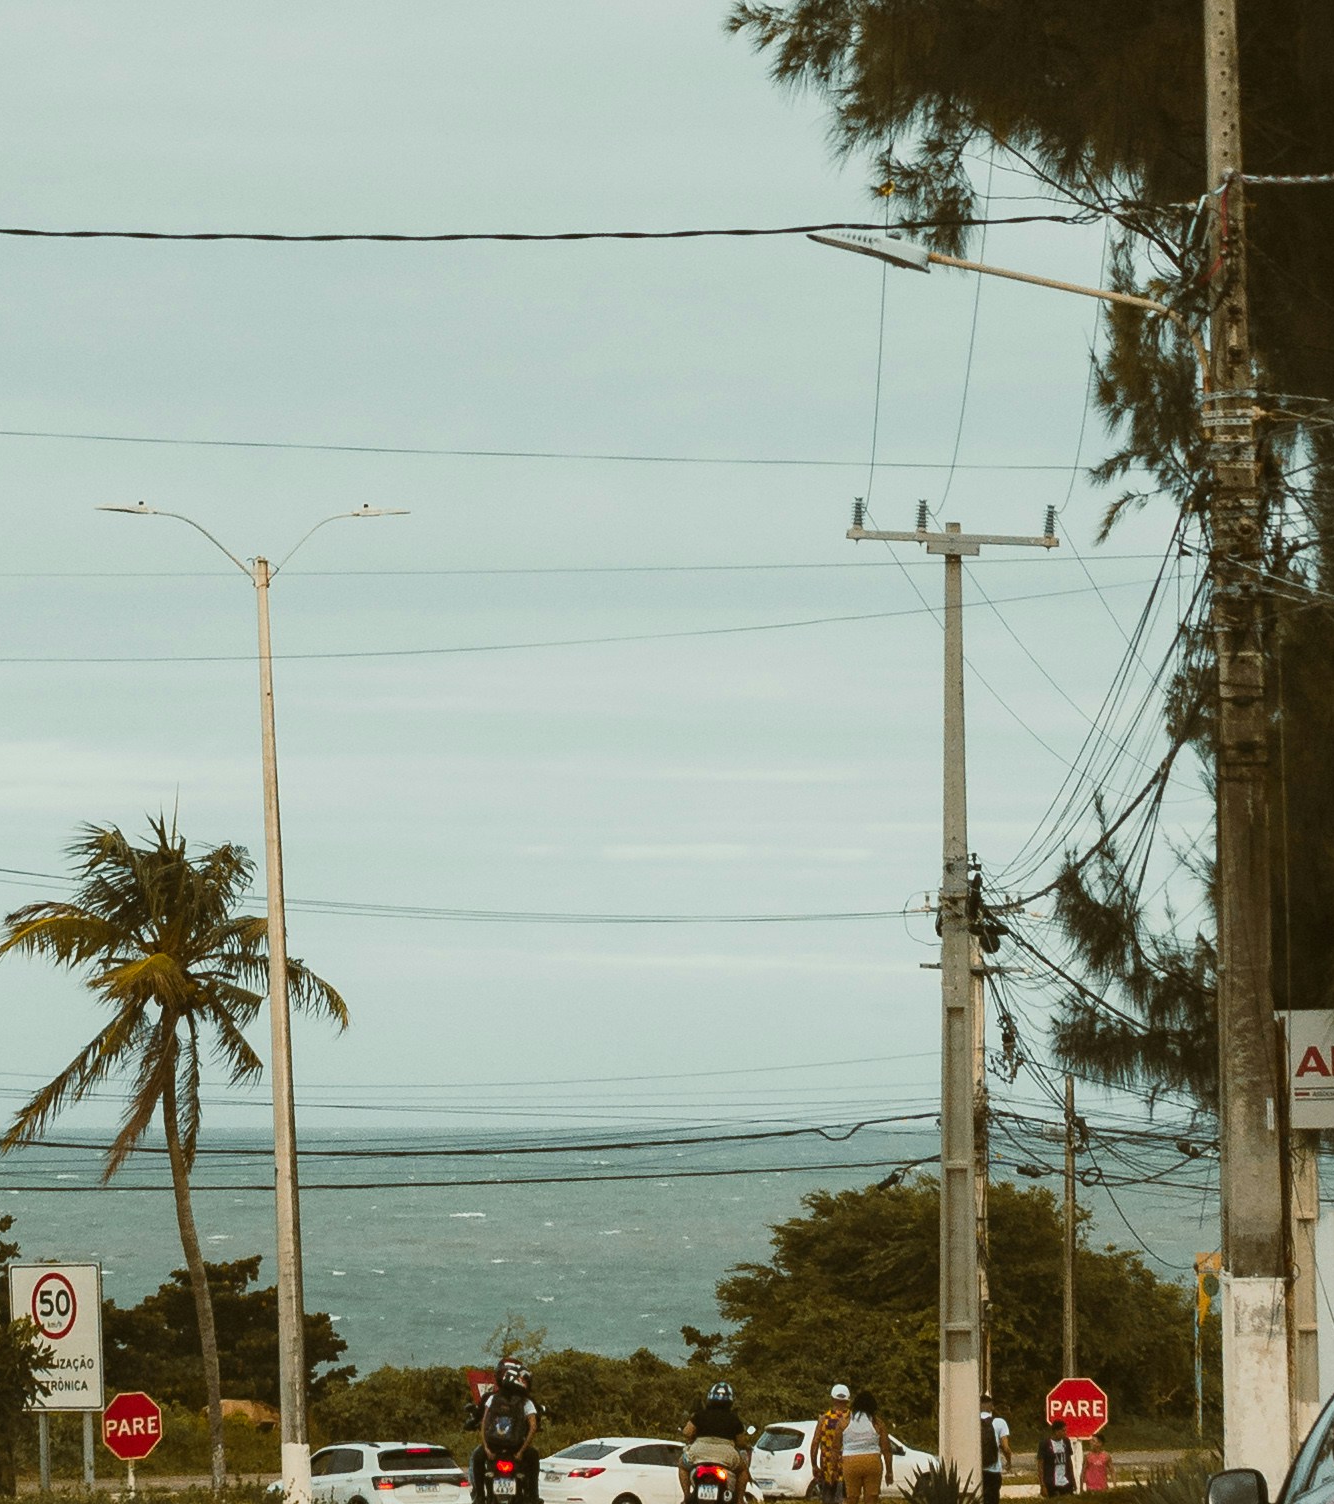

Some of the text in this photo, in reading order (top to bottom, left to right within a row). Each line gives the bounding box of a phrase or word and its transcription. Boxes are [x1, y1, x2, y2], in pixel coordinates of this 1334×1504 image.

[39, 1289, 71, 1317] 50
[1050, 1400, 1104, 1417] PARE
[106, 1416, 159, 1438] PARE
